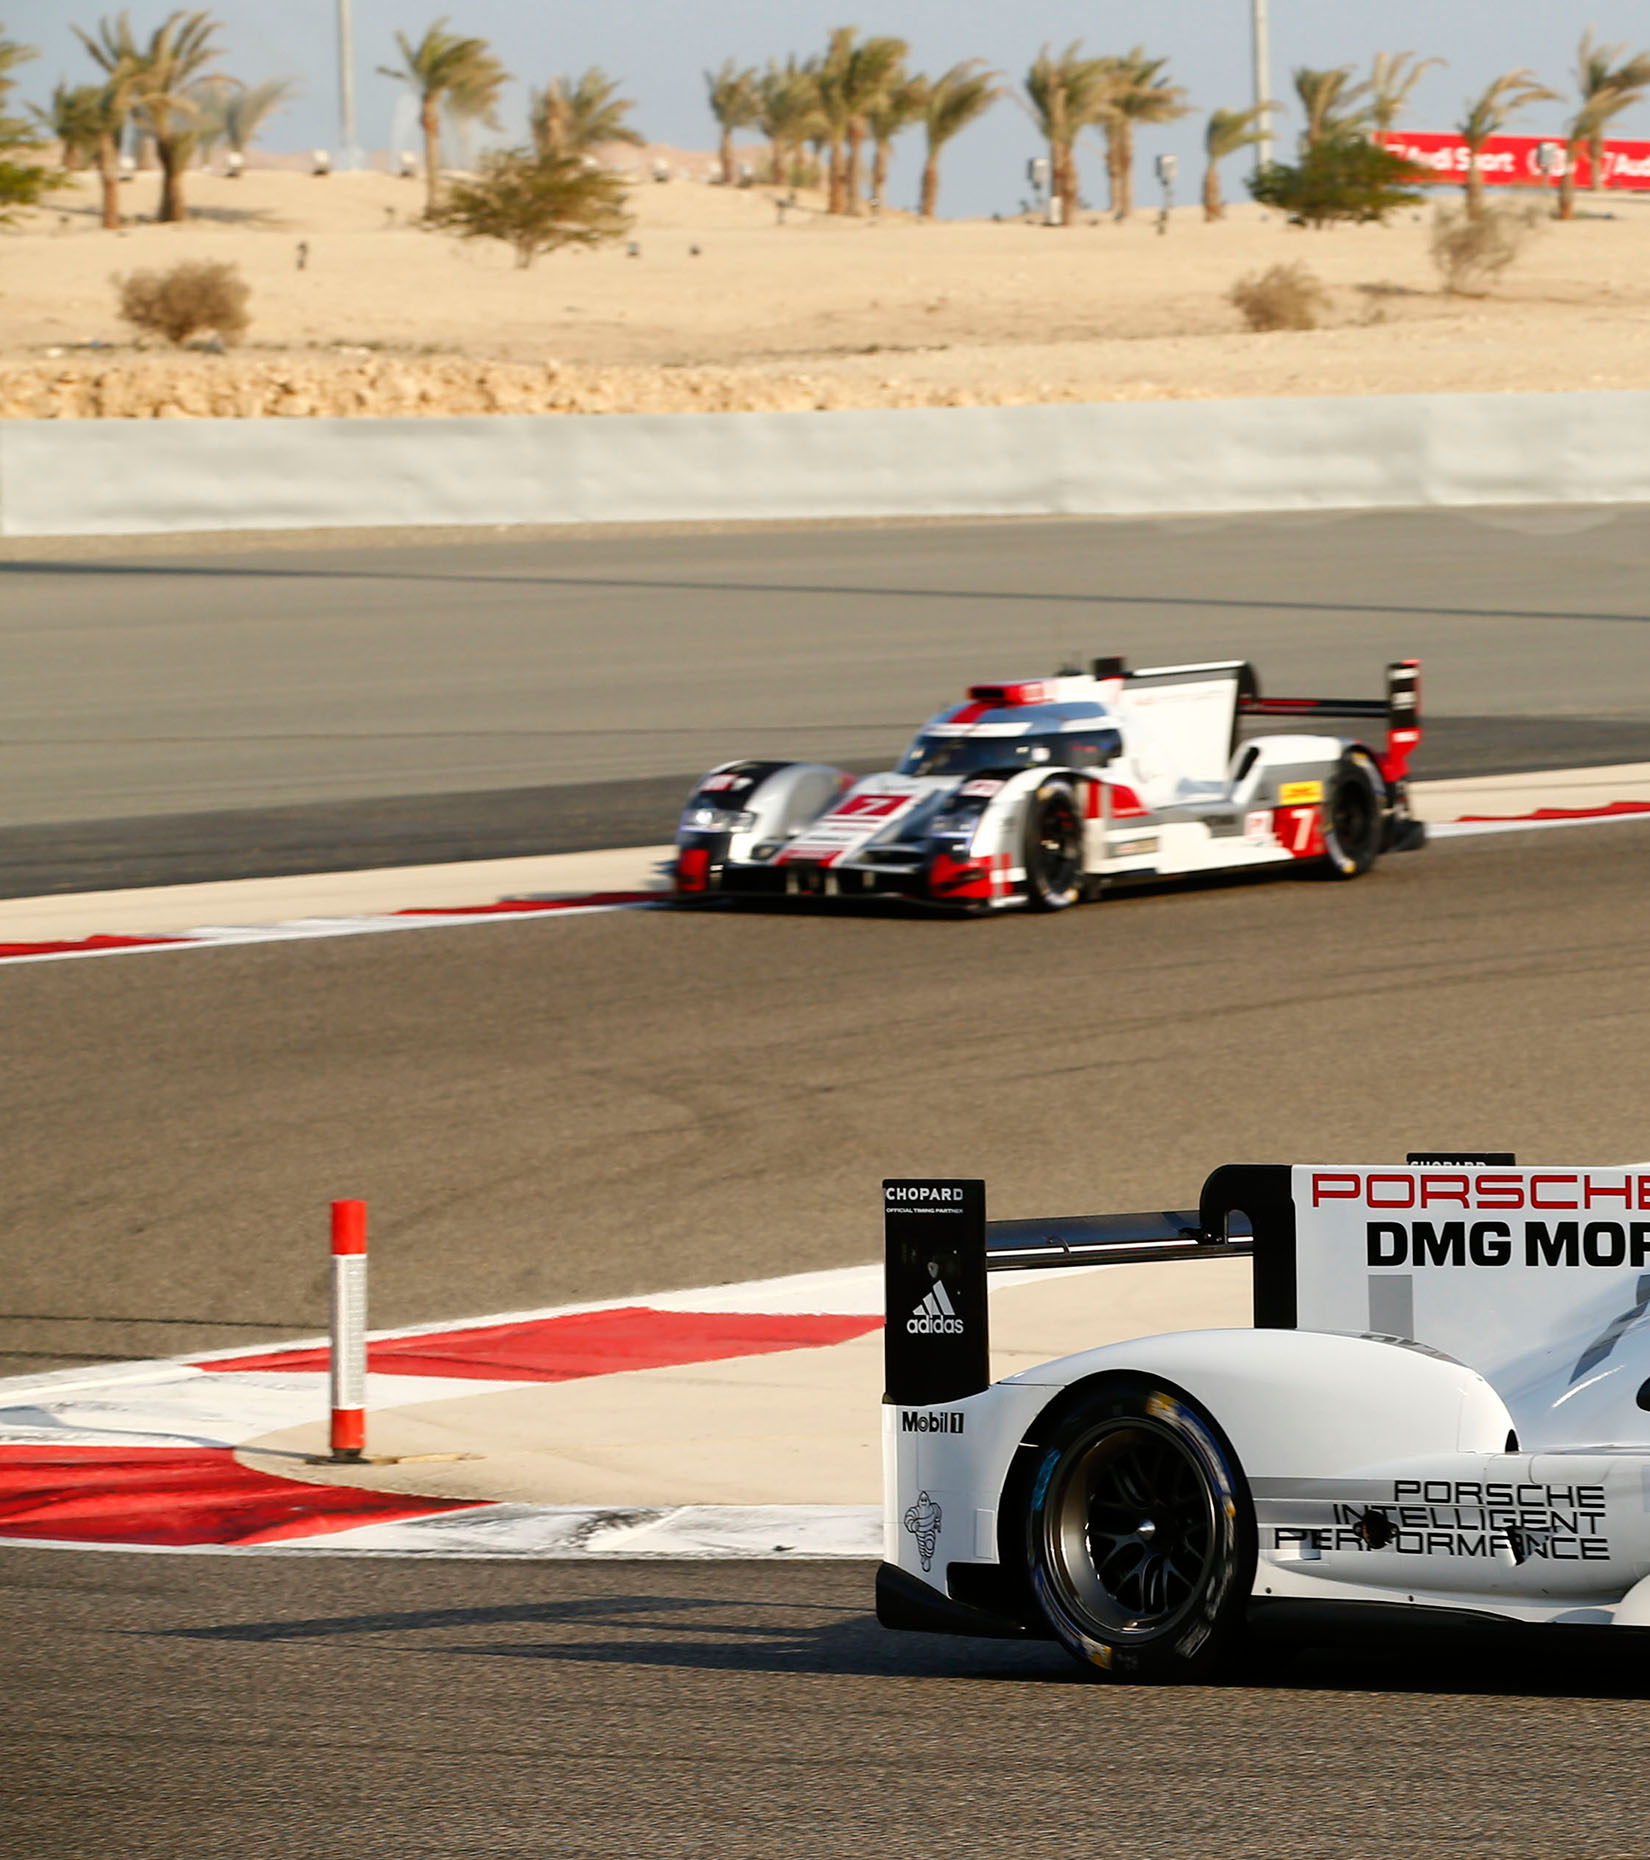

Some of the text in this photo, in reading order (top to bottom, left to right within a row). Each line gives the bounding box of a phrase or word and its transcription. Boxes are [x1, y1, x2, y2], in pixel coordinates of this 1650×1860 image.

[862, 797, 894, 815] 7
[1290, 808, 1314, 851] 7
[885, 1187, 964, 1201] CHOPARD
[1366, 1221, 1512, 1268] DMG
[906, 1315, 965, 1335] adidas
[1394, 1480, 1606, 1509] PORSCHE
[1274, 1527, 1611, 1560] PERORMANCE
